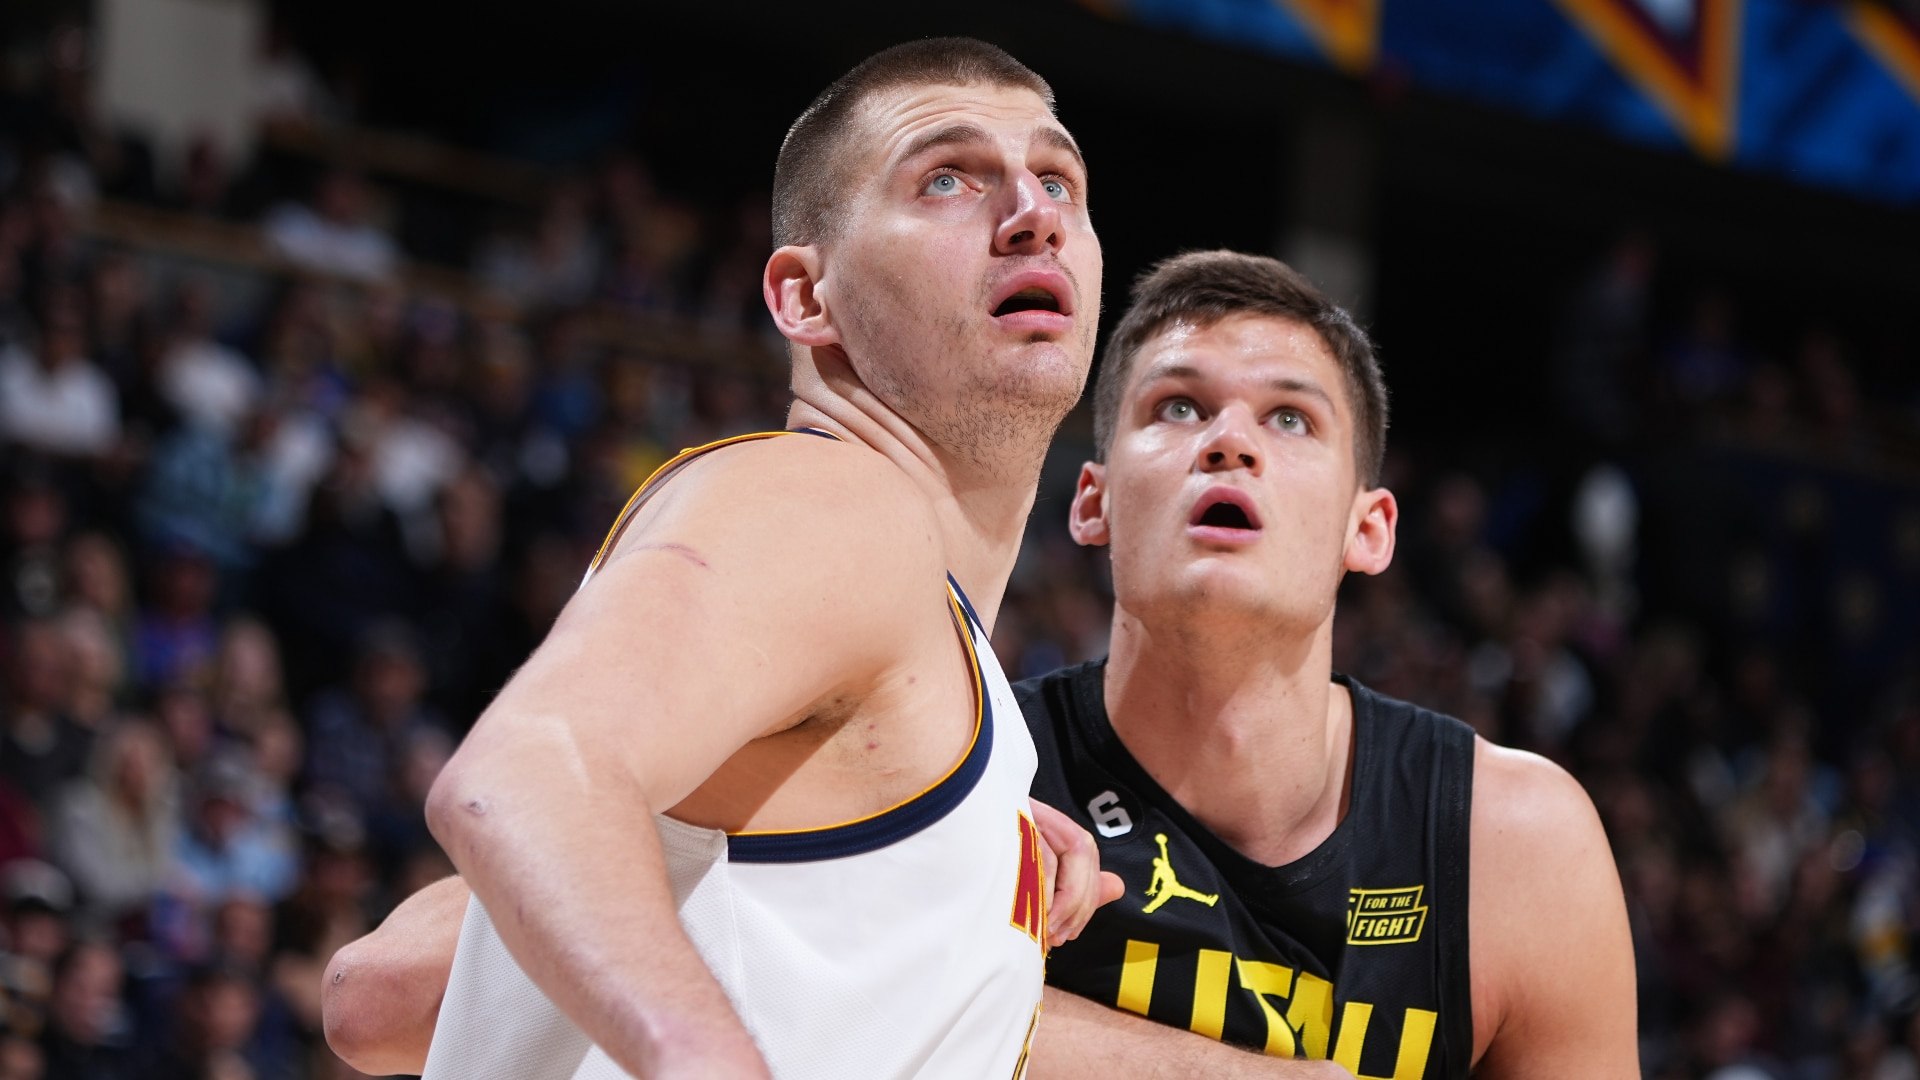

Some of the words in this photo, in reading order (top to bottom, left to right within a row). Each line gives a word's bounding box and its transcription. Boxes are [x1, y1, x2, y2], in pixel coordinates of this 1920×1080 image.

[1087, 790, 1133, 838] 6
[1010, 809, 1048, 960] N
[1364, 897, 1388, 909] FOR
[1389, 895, 1413, 908] THE
[1354, 915, 1418, 937] FIGHT
